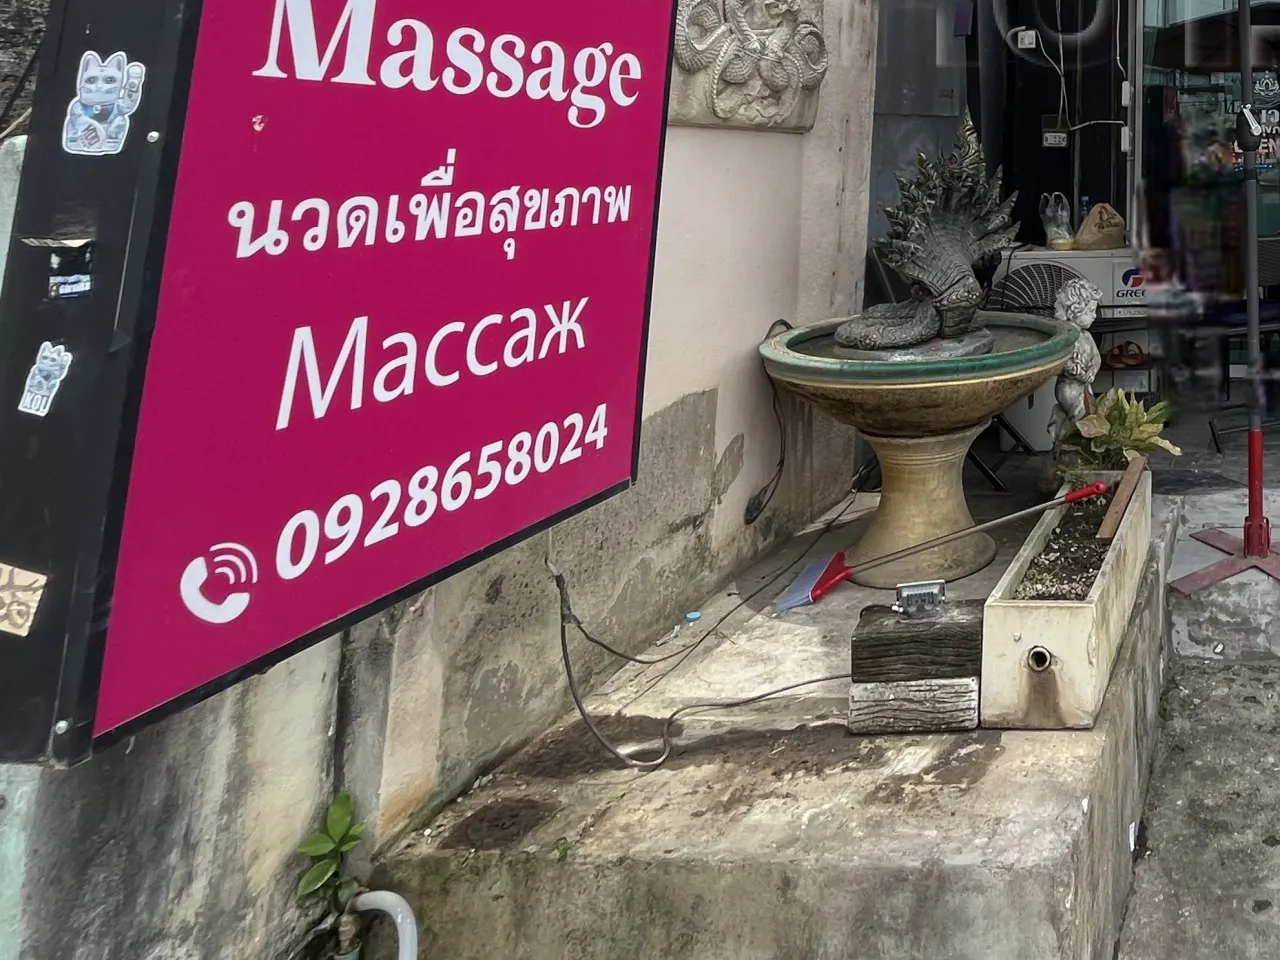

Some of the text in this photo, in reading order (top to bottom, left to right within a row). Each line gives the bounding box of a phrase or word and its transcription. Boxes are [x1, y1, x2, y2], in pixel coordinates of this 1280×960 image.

[227, 148, 632, 260] นวดเพื่อสุขภาพ
[275, 296, 589, 430] Массаж
[275, 402, 608, 580] 0928658024
